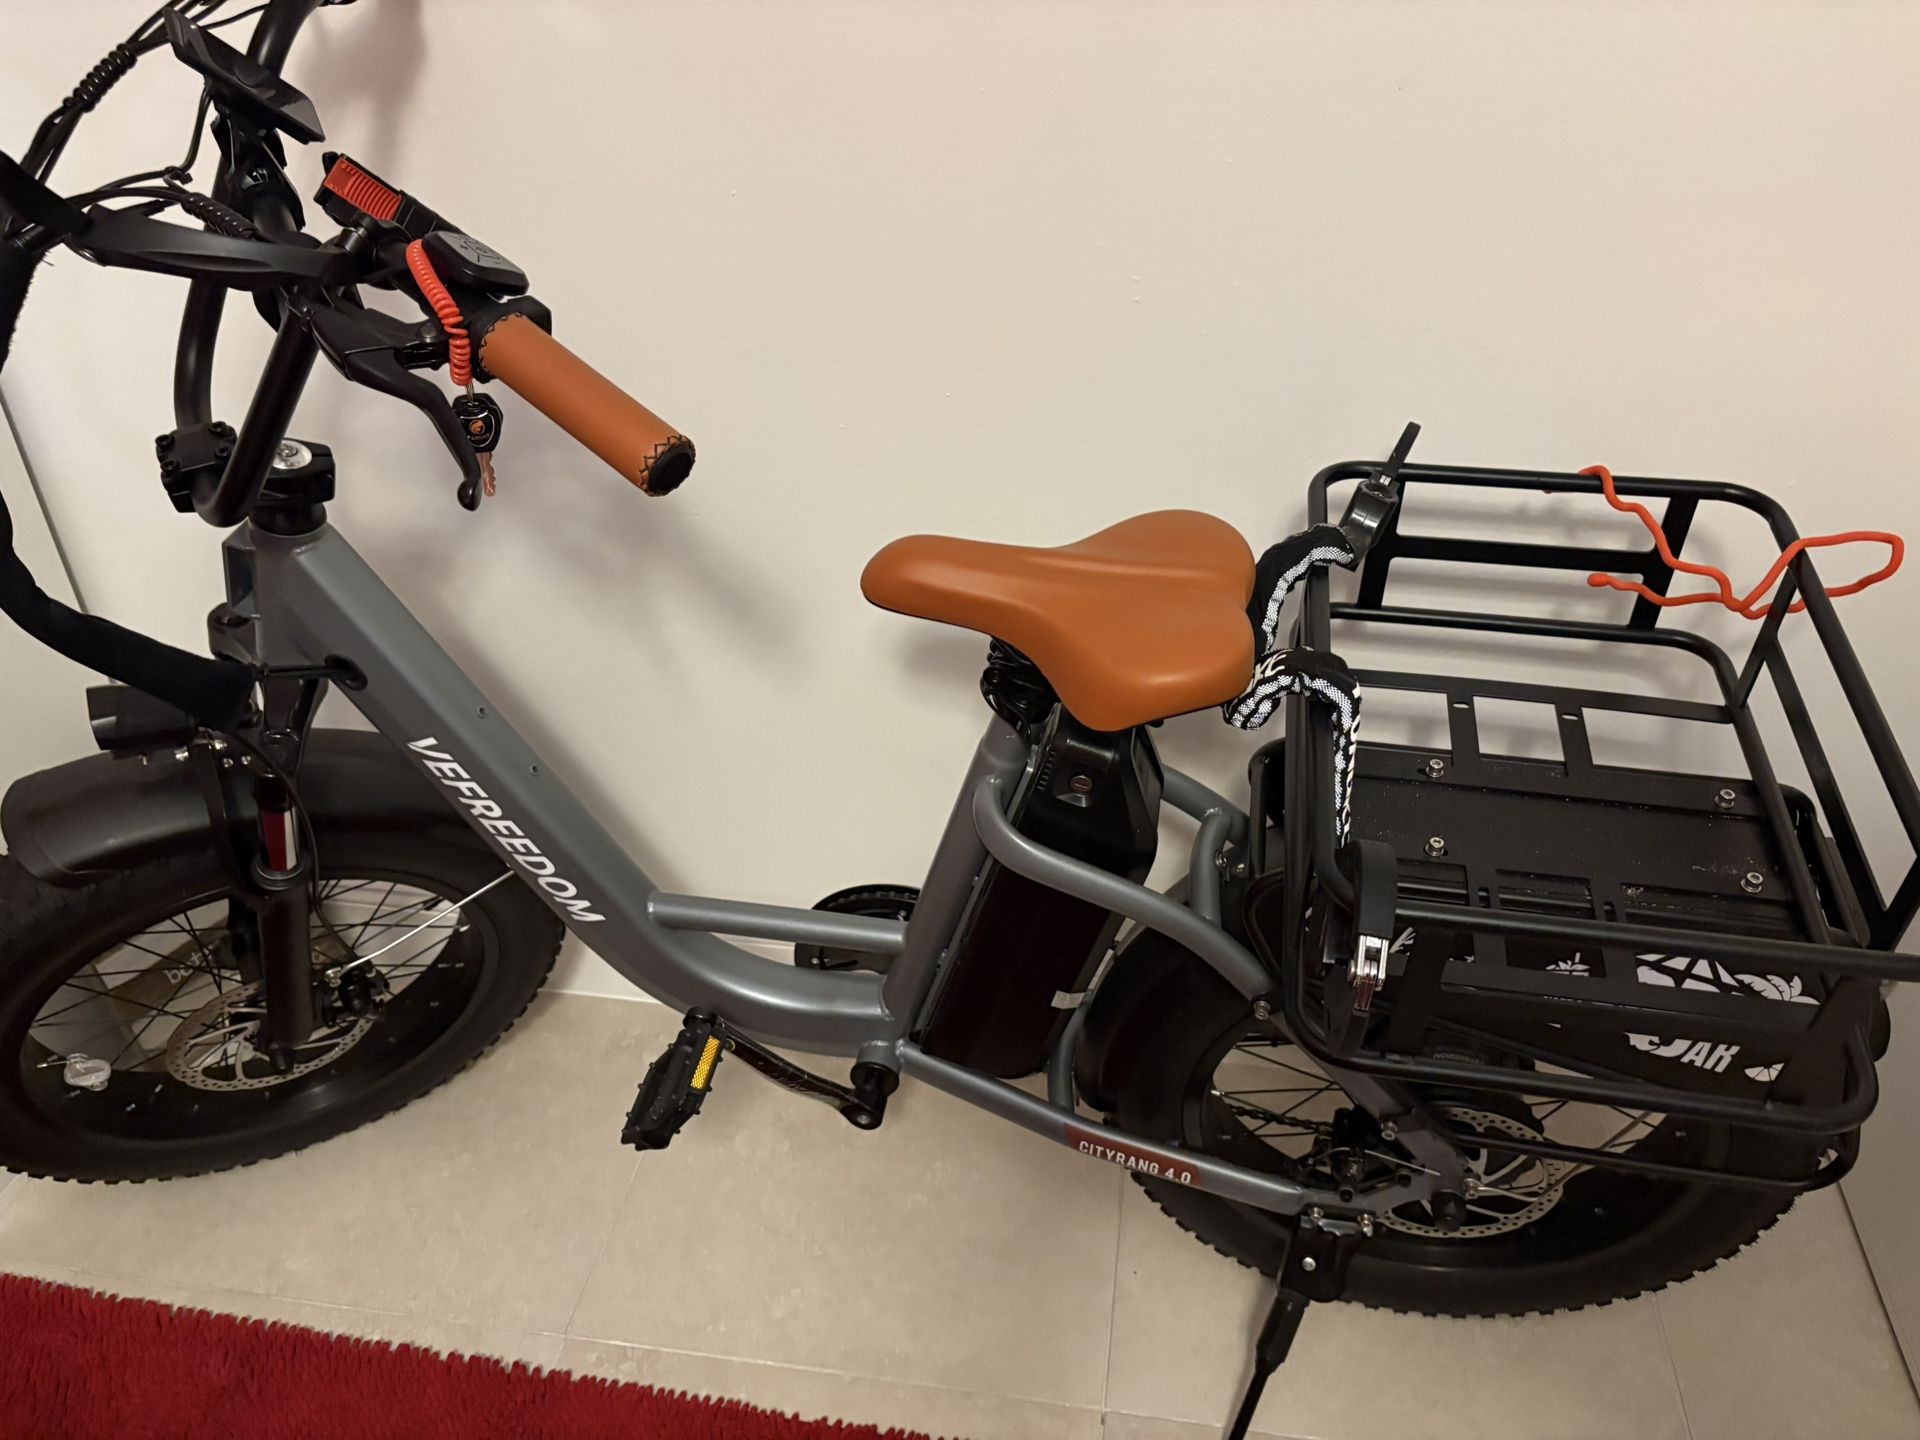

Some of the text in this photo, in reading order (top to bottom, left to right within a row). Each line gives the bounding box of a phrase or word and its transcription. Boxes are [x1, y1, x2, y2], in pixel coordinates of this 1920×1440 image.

[406, 736, 607, 922] VEFREEDOM
[1079, 1140, 1192, 1184] CITYRANG 4.0
